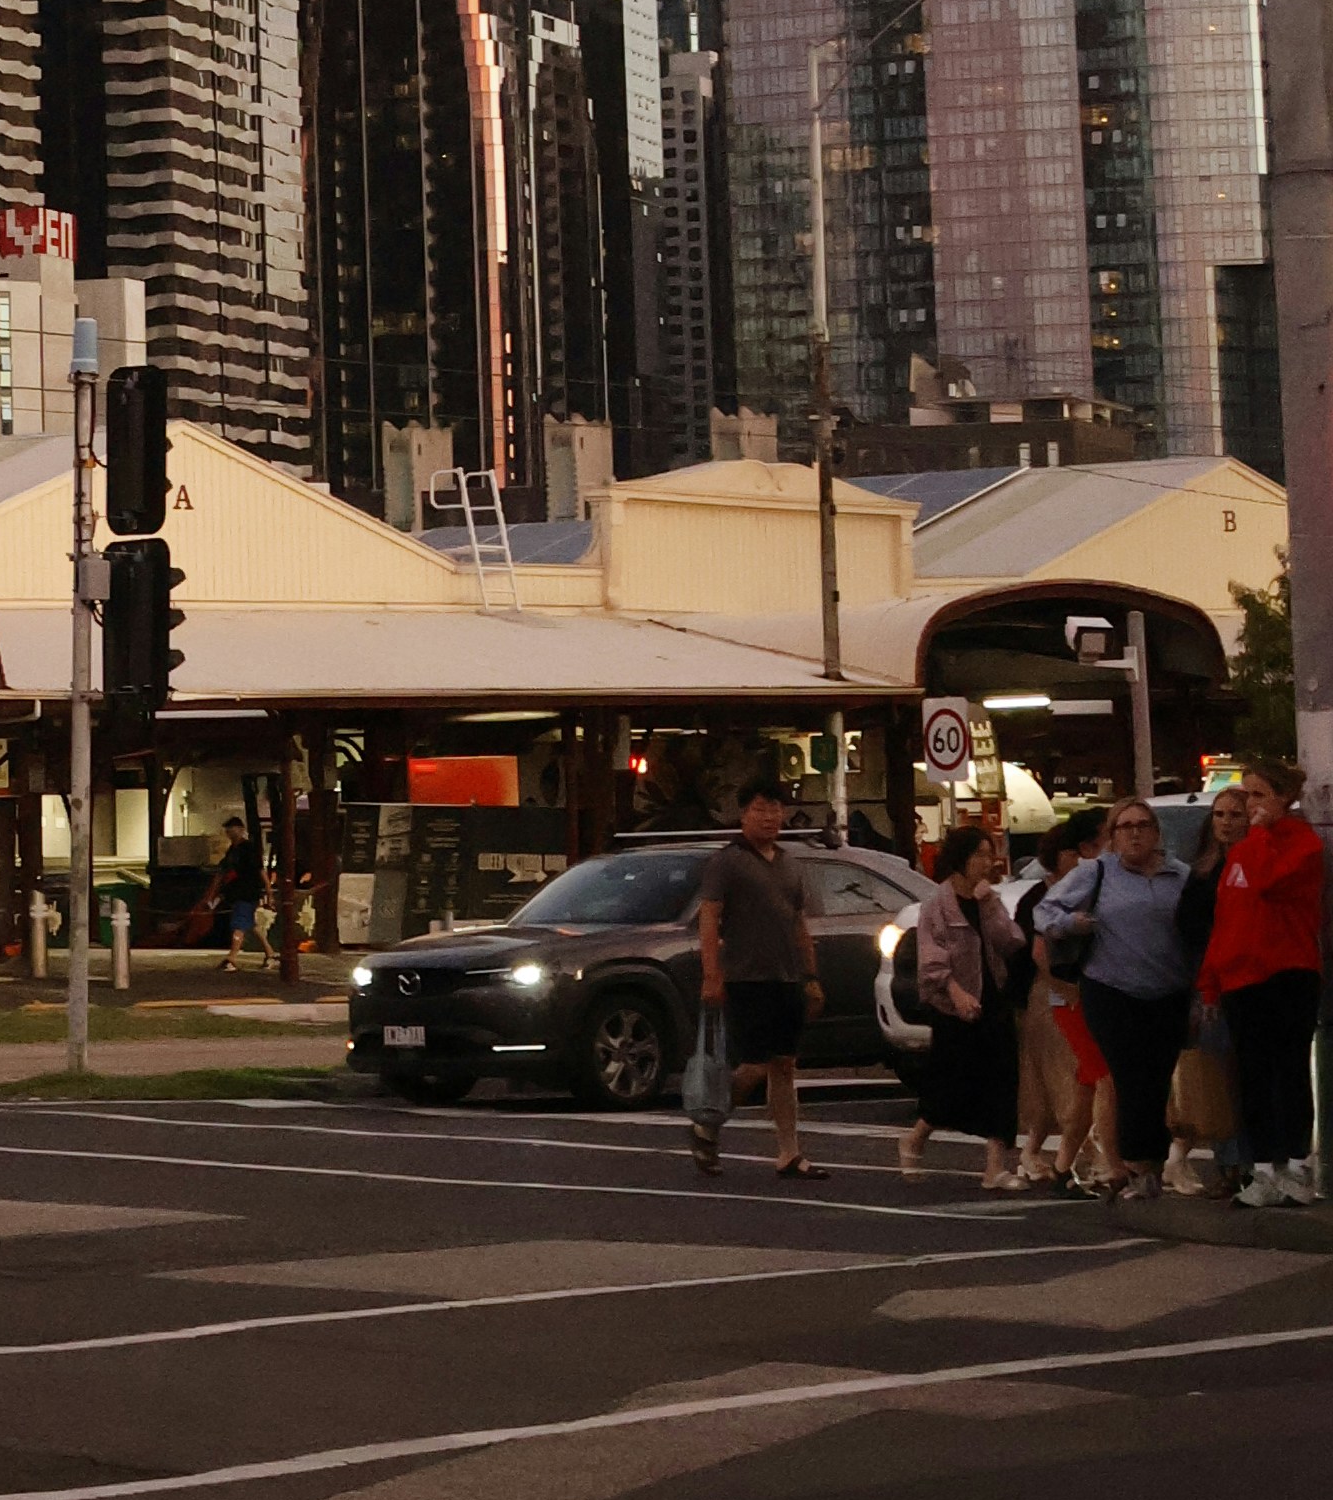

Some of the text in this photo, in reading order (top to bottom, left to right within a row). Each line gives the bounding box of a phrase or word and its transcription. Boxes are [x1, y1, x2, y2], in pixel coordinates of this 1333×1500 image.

[173, 486, 194, 510] A
[1222, 511, 1237, 532] B
[933, 727, 960, 753] 60
